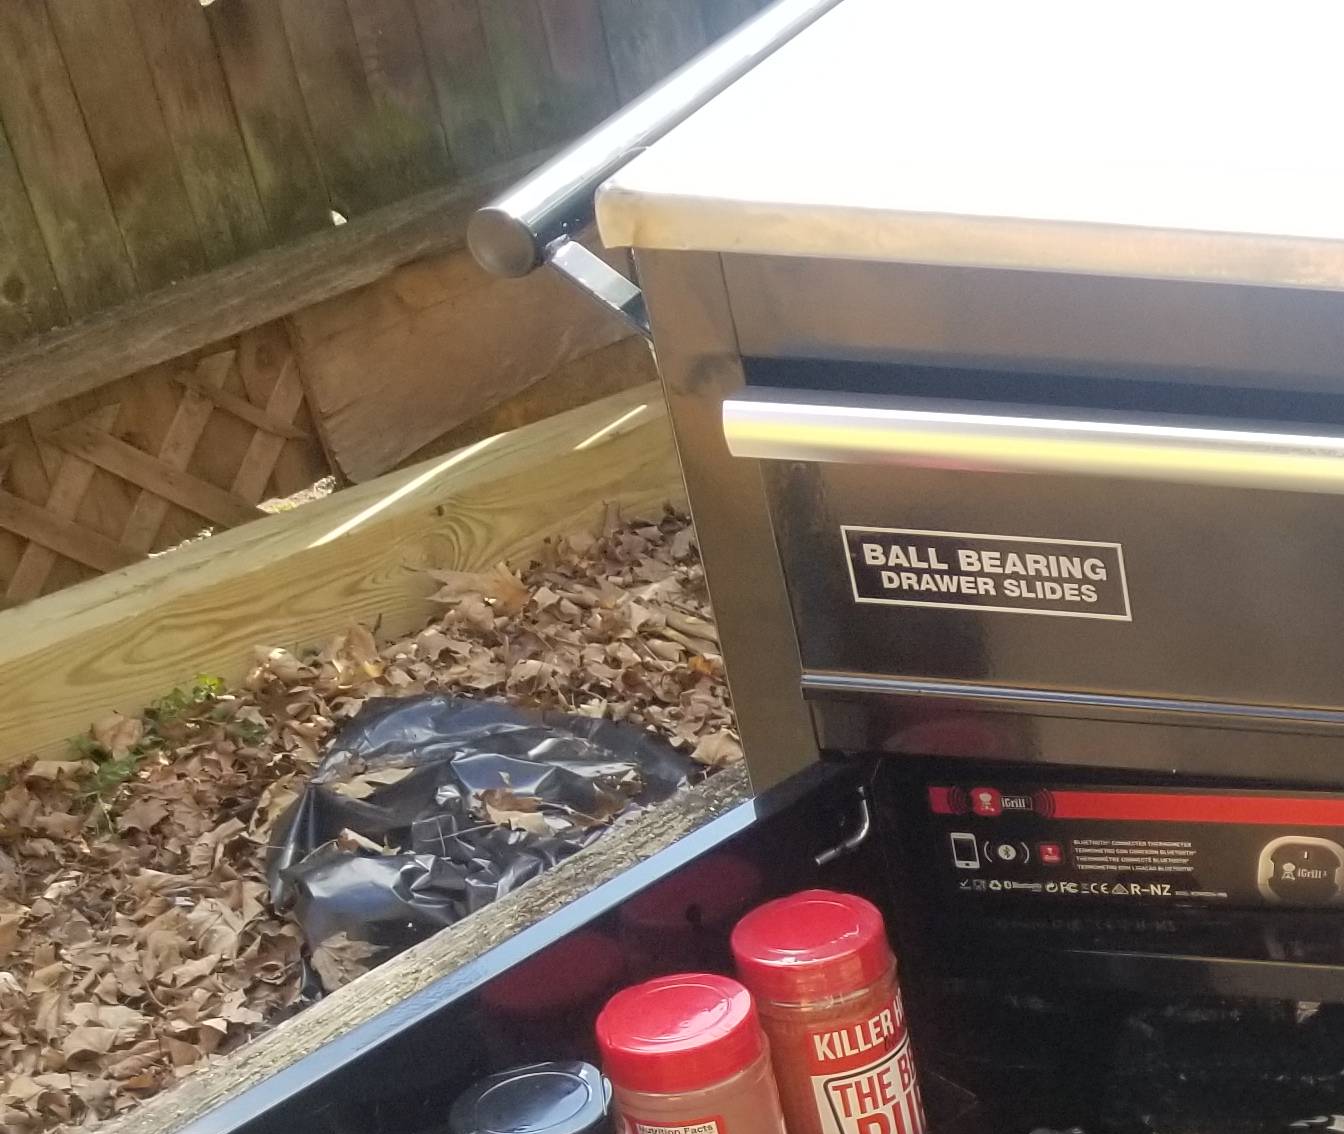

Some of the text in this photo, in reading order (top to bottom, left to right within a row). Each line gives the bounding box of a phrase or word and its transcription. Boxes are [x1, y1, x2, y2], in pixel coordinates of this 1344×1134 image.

[862, 543, 1107, 581] BALL BEARING
[880, 570, 1098, 602] DRAWER SLIDES
[813, 1008, 895, 1062] KILLER
[832, 1066, 897, 1119] THE
[684, 1124, 714, 1134] Facts
